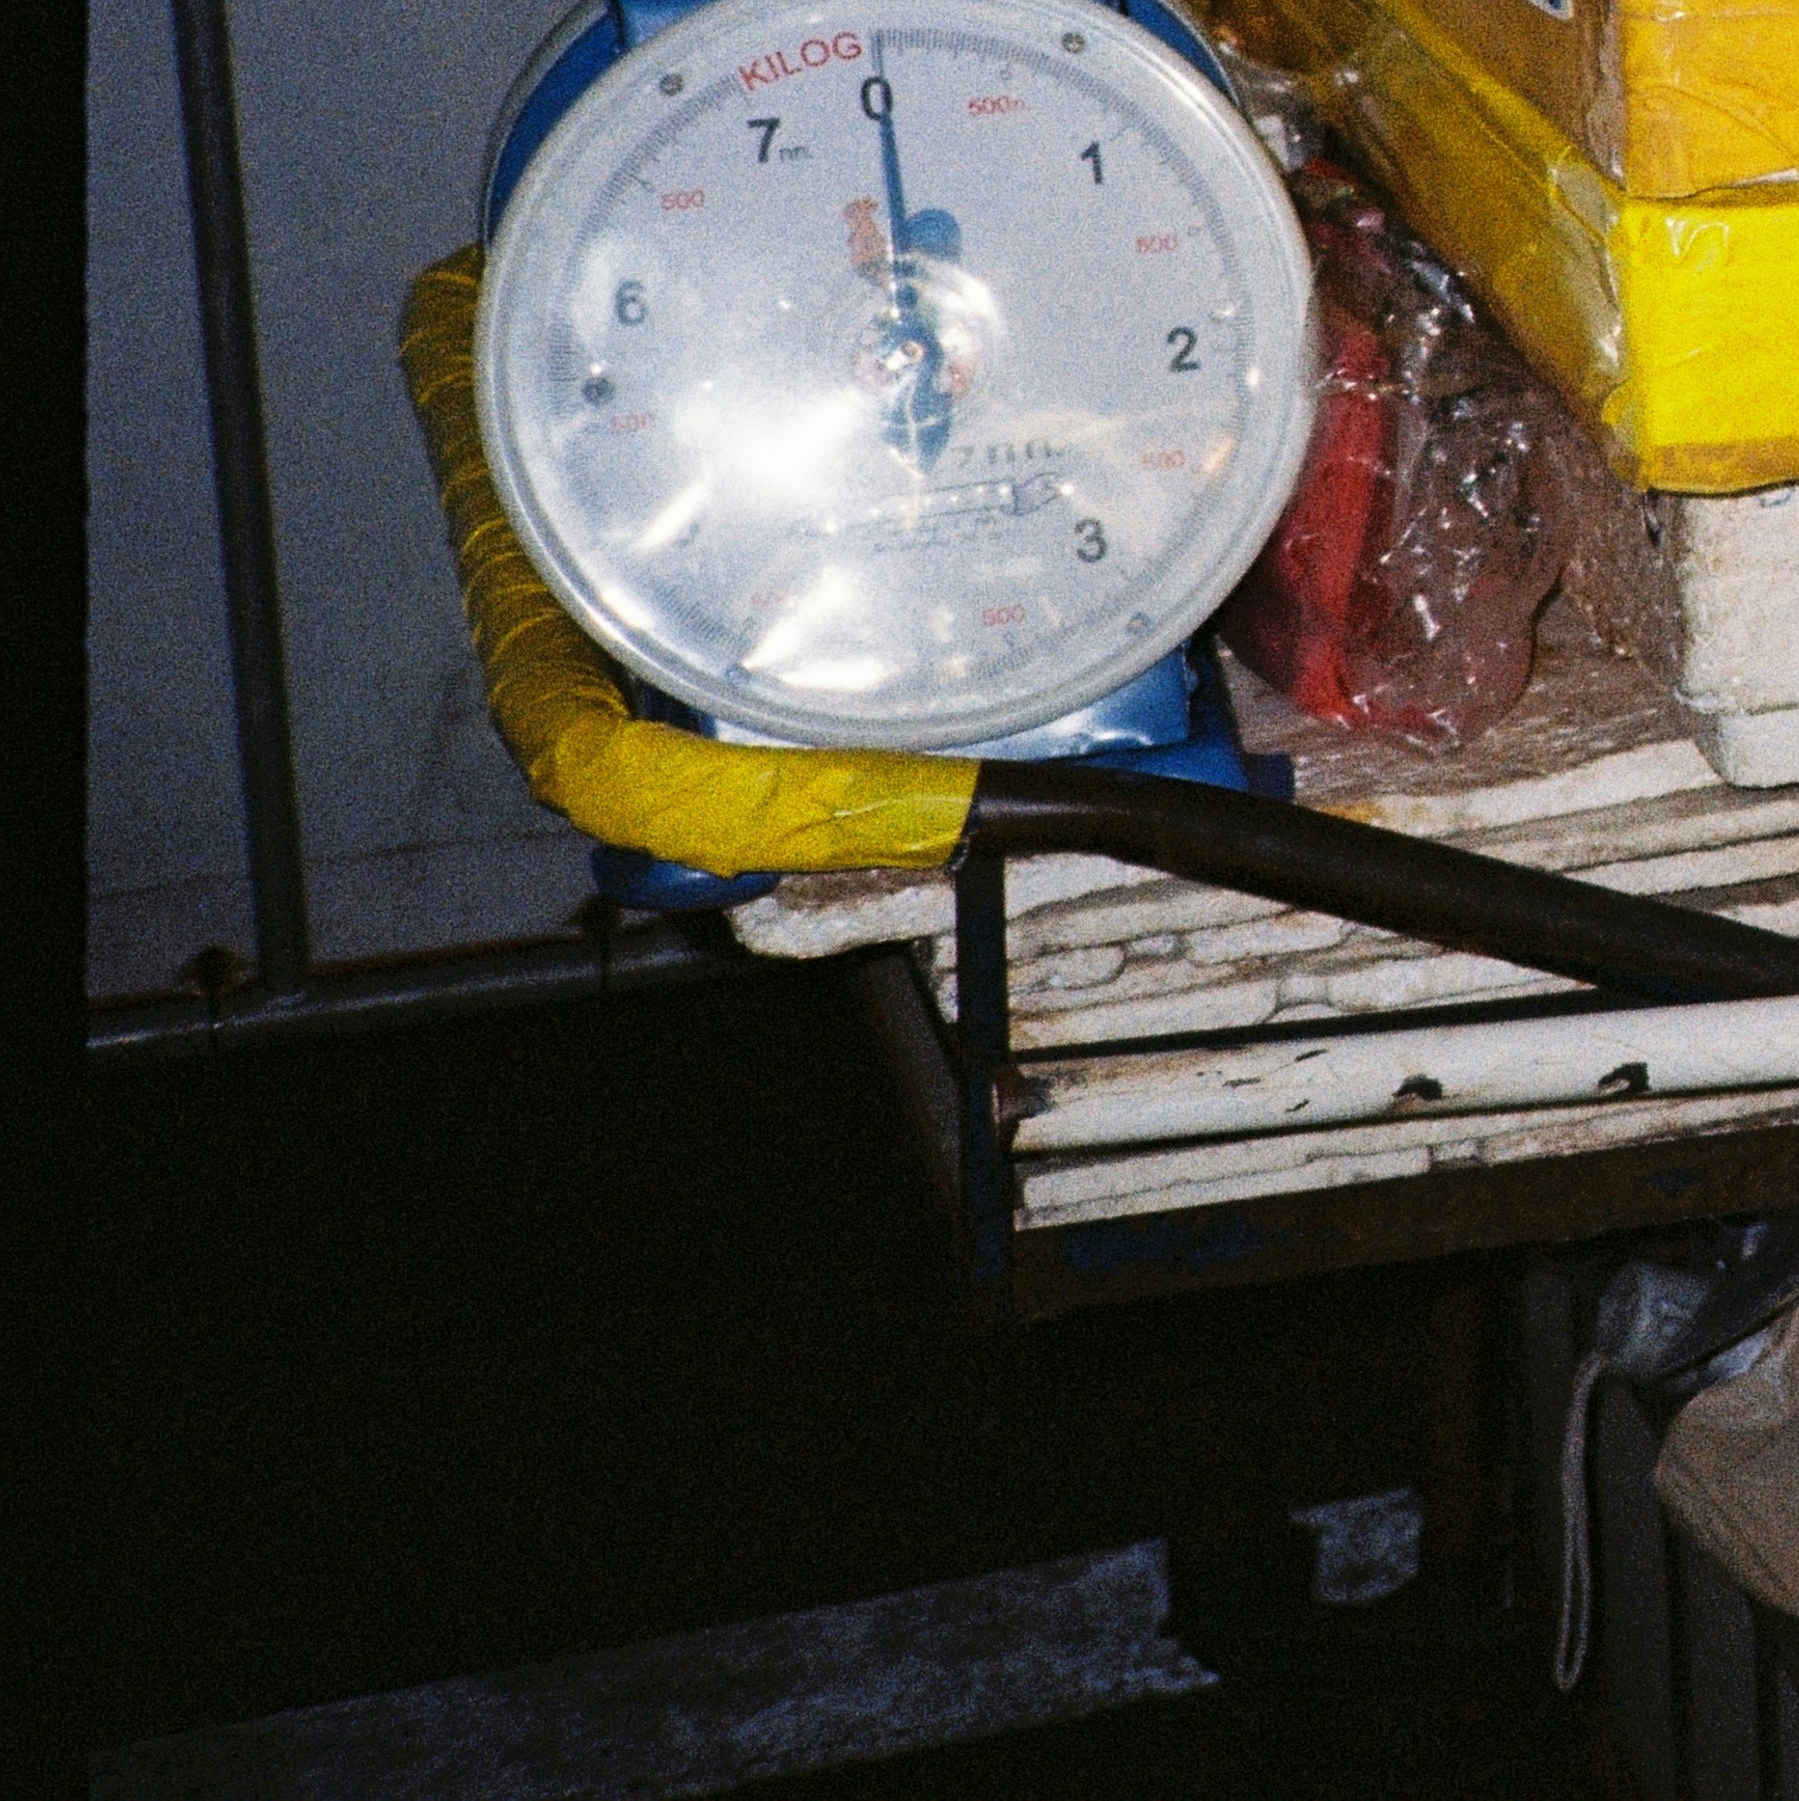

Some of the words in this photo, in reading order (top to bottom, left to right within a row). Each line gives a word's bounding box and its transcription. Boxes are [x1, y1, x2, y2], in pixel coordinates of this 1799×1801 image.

[739, 31, 863, 91] KILOG
[861, 76, 893, 121] 0
[748, 117, 780, 163] 7
[1081, 141, 1103, 185] 1
[661, 189, 705, 213] 500
[613, 279, 648, 327] 6
[1166, 326, 1200, 374] 2
[1073, 518, 1107, 563] 3
